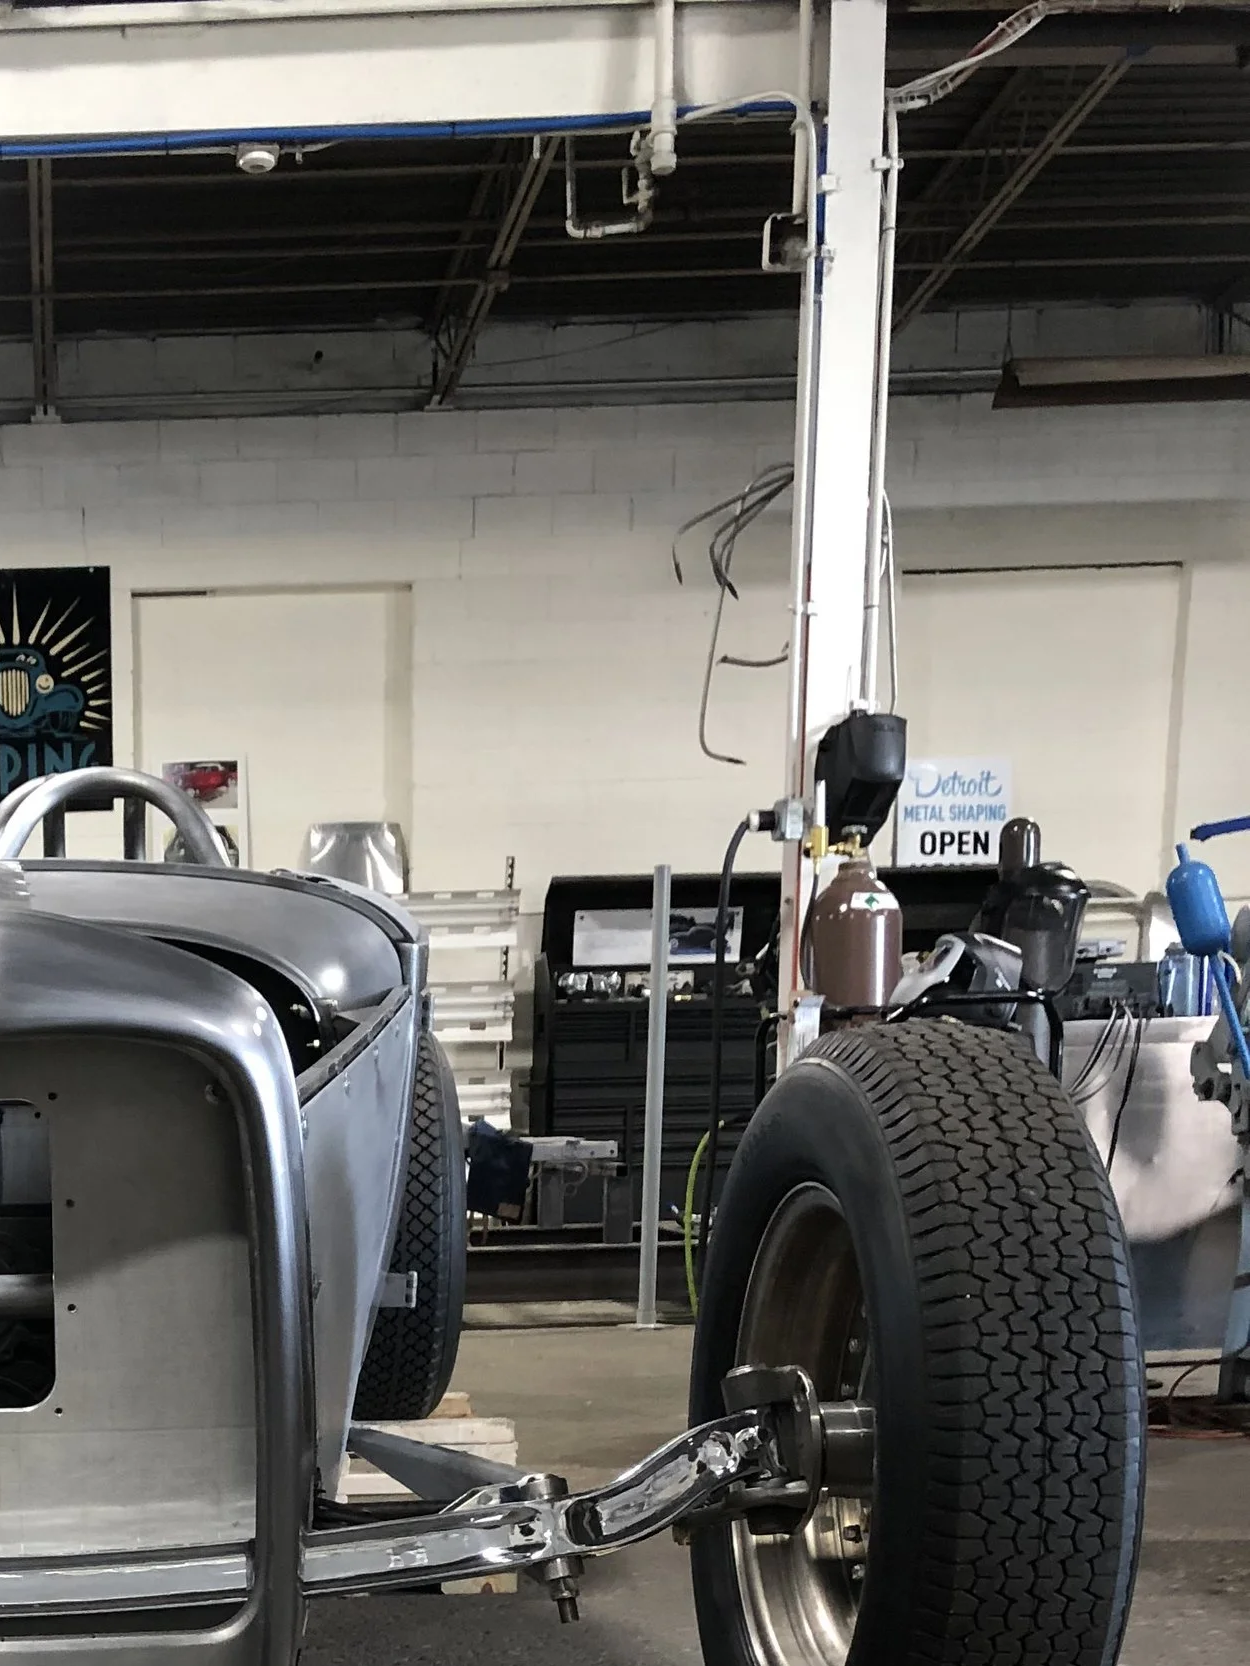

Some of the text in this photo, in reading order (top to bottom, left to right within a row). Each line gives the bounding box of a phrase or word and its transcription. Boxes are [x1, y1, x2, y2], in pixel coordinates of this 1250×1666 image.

[909, 763, 1003, 798] Detroit
[903, 803, 1007, 822] METAL SHAPING
[919, 831, 990, 856] OPEN
